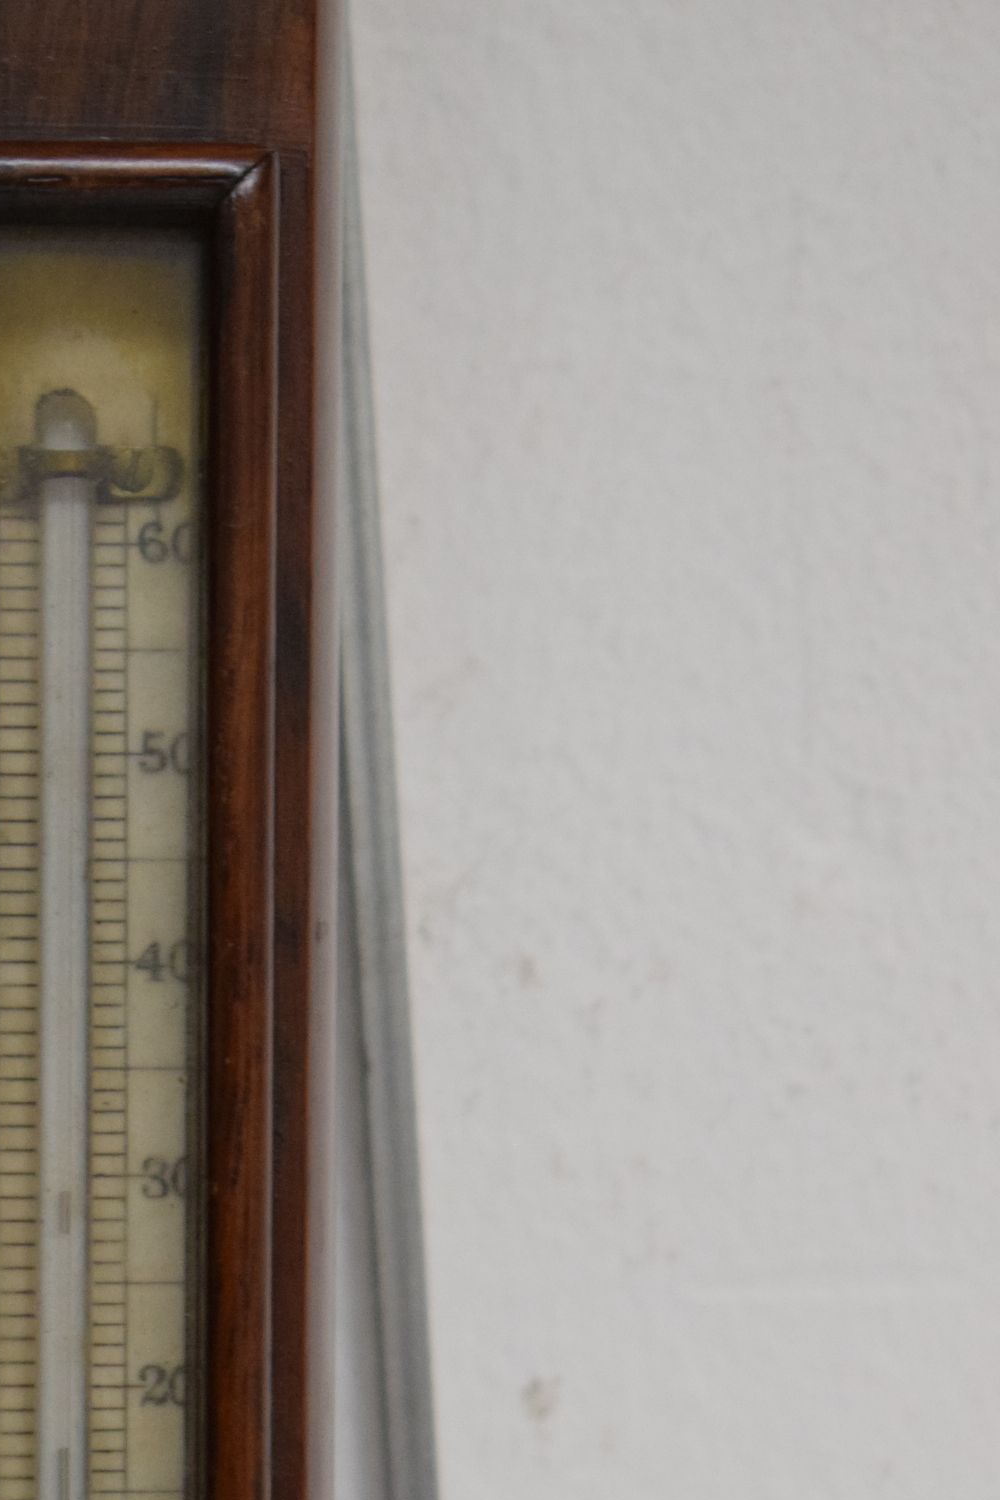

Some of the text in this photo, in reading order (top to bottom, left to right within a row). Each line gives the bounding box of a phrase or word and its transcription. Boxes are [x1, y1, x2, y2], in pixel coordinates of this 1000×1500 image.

[138, 520, 191, 564] 60
[138, 730, 191, 775] 50
[135, 941, 189, 983] 40
[141, 1156, 187, 1199] 30
[138, 1364, 186, 1407] 20
